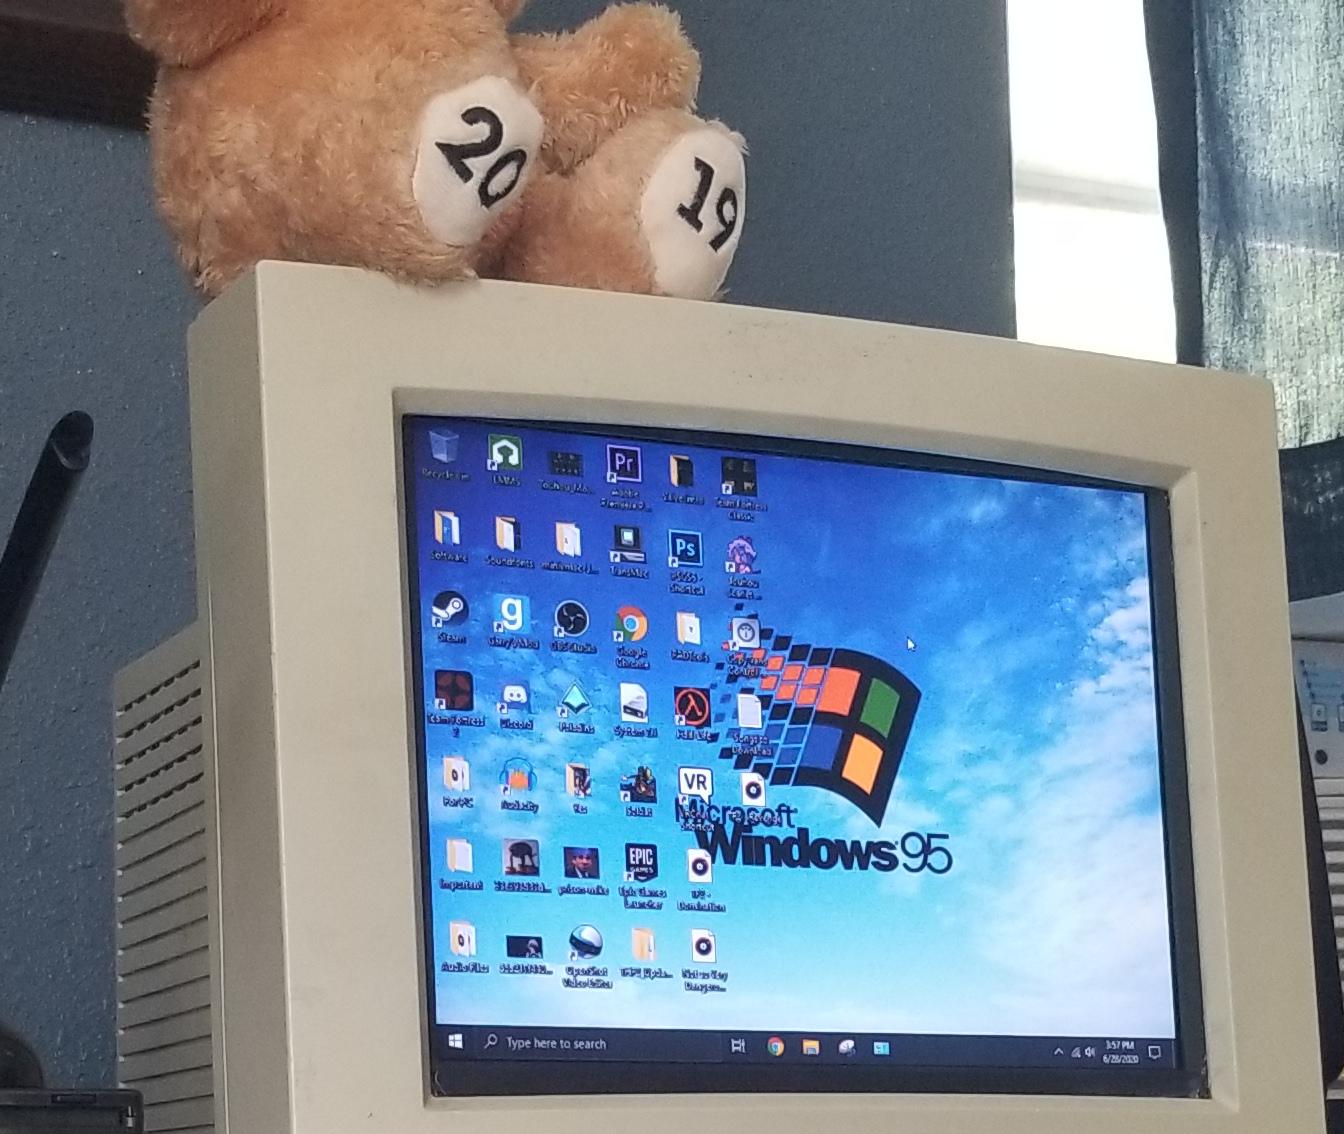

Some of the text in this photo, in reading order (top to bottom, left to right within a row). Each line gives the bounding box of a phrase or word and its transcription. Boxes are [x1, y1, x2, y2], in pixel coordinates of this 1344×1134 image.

[435, 106, 527, 209] 20
[676, 156, 738, 253] 19
[614, 452, 635, 472] Pr
[675, 538, 696, 557] Ps
[683, 772, 708, 791] VR
[675, 796, 795, 828] Microsoft
[629, 847, 654, 866] EPIC
[695, 825, 954, 875] Windows 95
[506, 1038, 607, 1052] Type here to search
